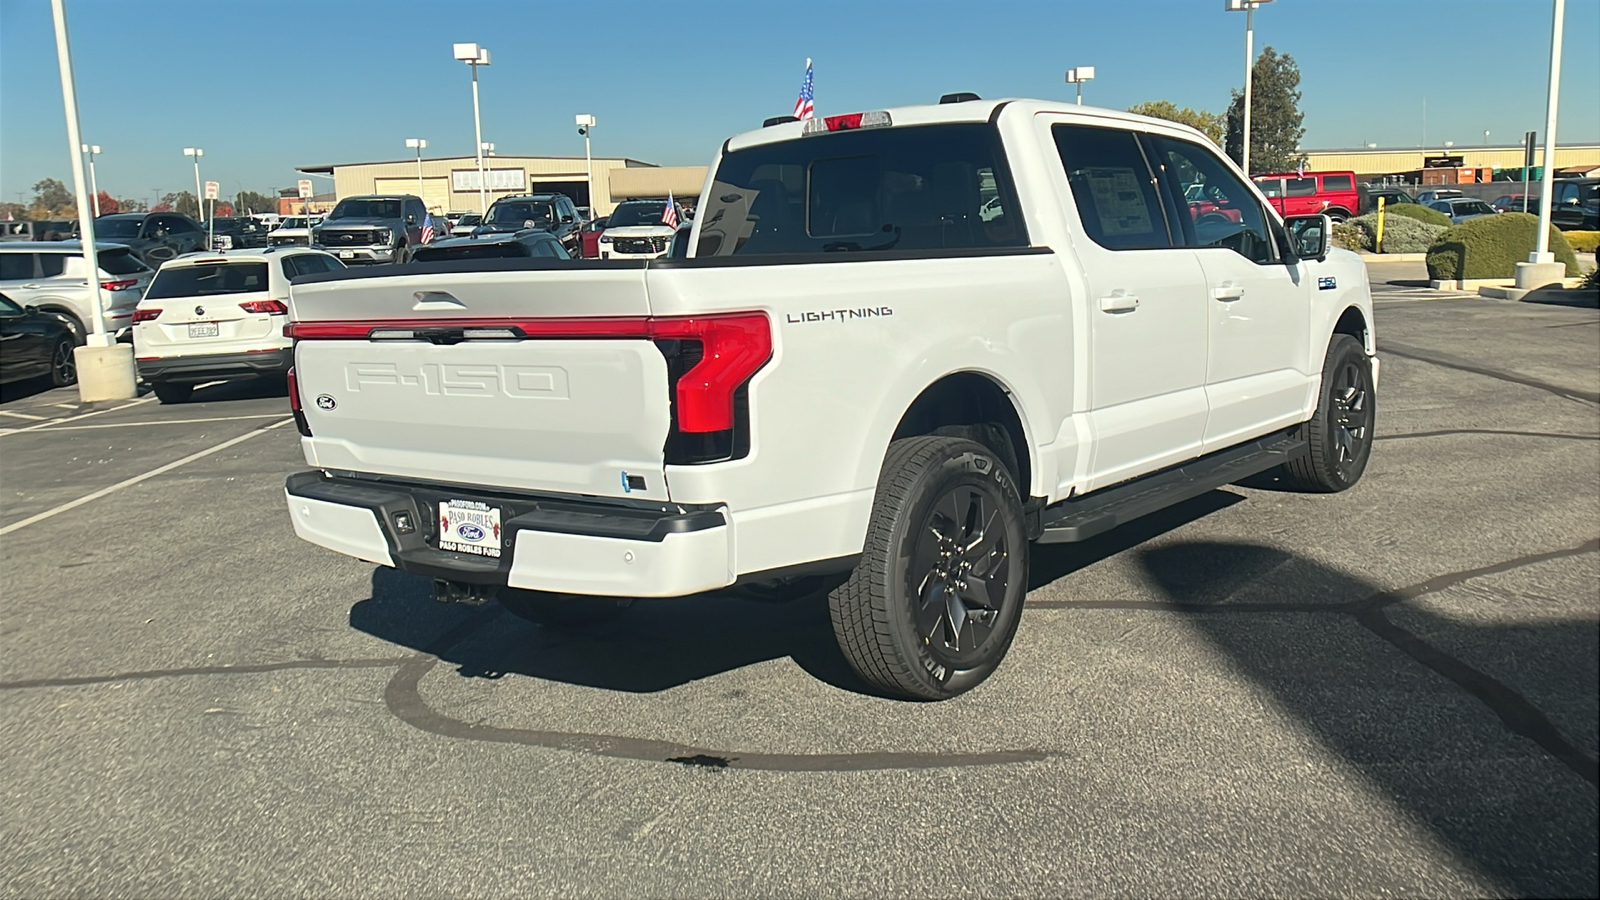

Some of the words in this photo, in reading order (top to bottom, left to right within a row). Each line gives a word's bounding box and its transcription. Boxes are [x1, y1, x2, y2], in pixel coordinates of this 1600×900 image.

[787, 307, 893, 323] LIGHTNING
[345, 362, 570, 400] F-150
[449, 511, 465, 525] PASO
[467, 513, 494, 530] ROBLES
[462, 526, 481, 539] Ford
[439, 541, 457, 551] PASO
[457, 544, 483, 555] ROBLES
[483, 547, 501, 557] FORD
